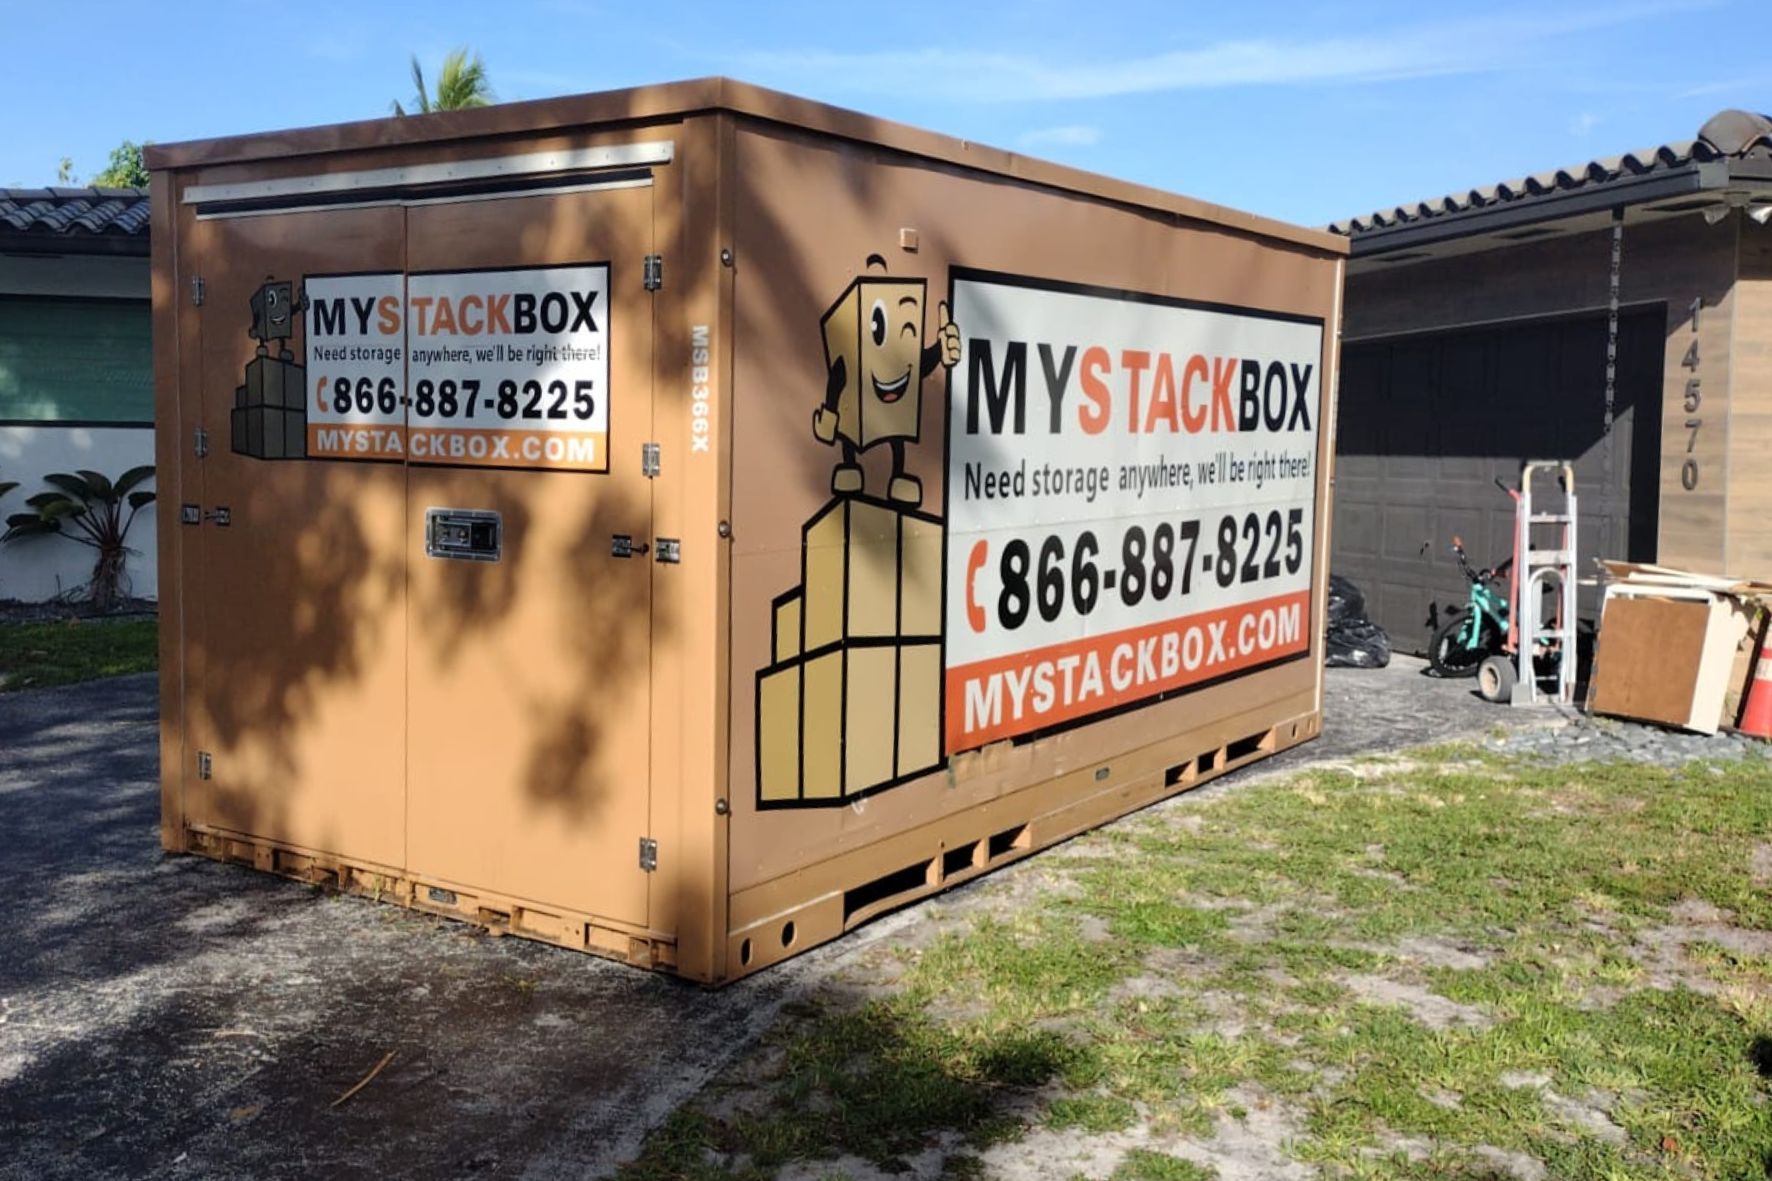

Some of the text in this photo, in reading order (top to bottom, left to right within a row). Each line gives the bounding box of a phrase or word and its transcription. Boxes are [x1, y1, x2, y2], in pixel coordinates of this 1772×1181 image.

[313, 290, 600, 337] MYSTACKBOX
[314, 343, 601, 366] Need storage anywhere, we'll be right there!
[692, 325, 709, 452] MSB366X
[965, 338, 1313, 436] MYSTACKBOX
[333, 376, 595, 420] 866-887-8225
[1681, 297, 1702, 491] 14570
[317, 429, 595, 462] MYSTACKBOX.COM
[964, 446, 1311, 503] Need storage anywhere, we'll be right there!
[998, 508, 1304, 630] 866-887-8225
[963, 603, 1300, 734] MYSTACKBOX.COM
